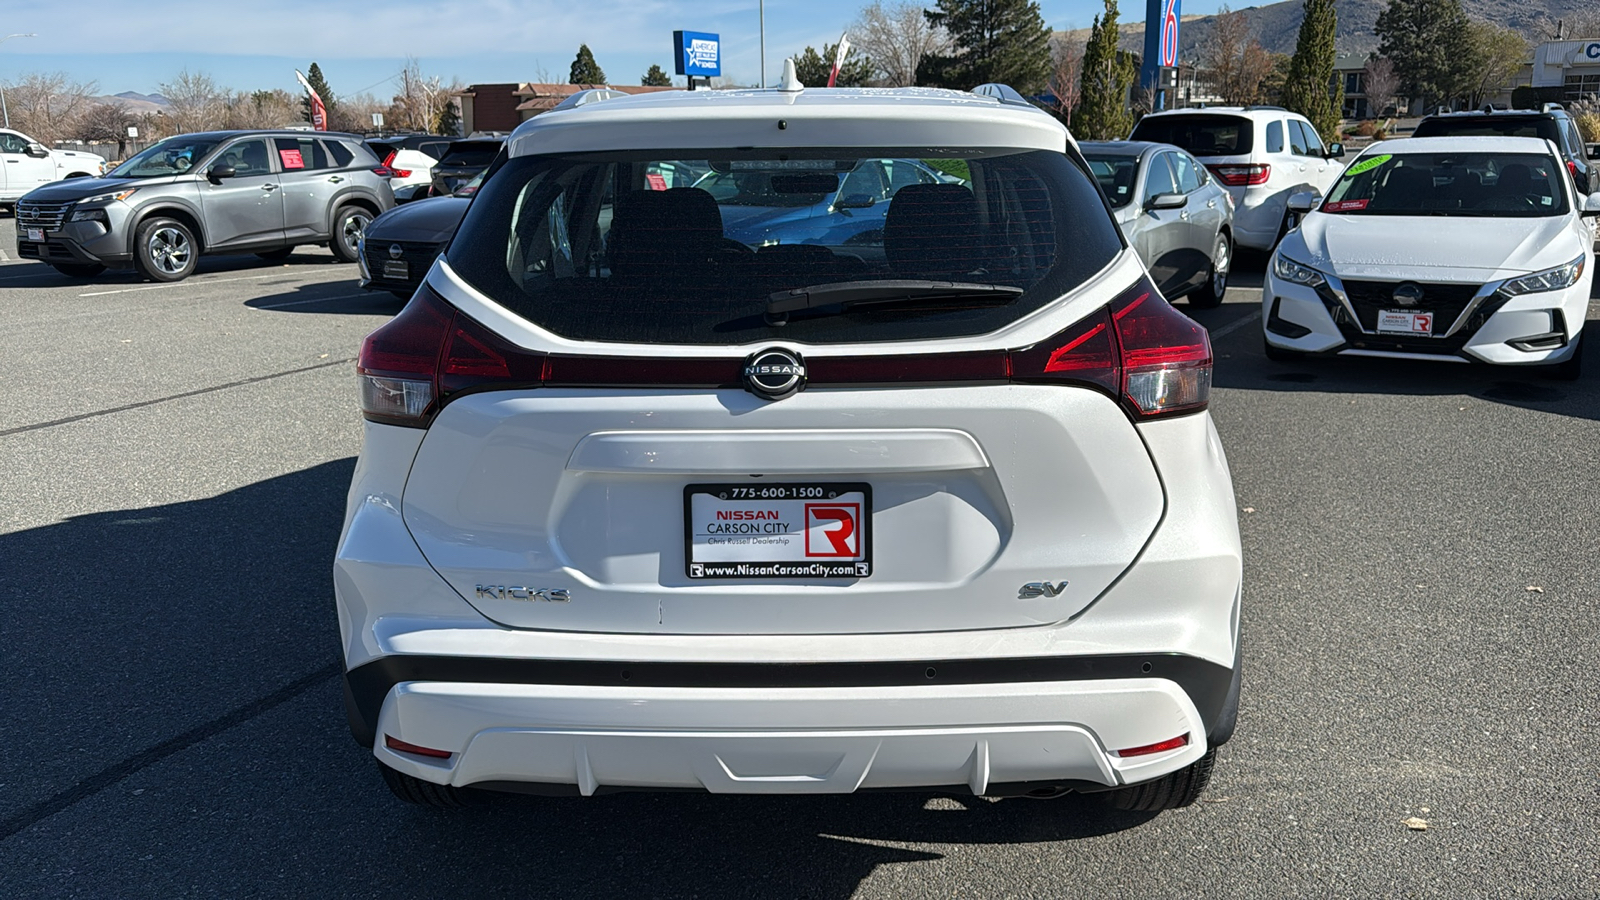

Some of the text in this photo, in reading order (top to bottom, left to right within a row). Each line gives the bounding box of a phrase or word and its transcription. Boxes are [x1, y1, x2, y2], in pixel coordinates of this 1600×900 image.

[1162, 0, 1178, 66] 6
[745, 365, 802, 374] NISSAN
[731, 487, 824, 498] 775-600-1500
[716, 510, 779, 520] NISSAN
[707, 522, 790, 534] CARSON CITY
[810, 508, 855, 556] R
[707, 537, 790, 547] Chris Russell Dealership
[705, 564, 854, 577] www.NissanCarsonCity.com
[475, 584, 571, 603] KICKS
[1017, 581, 1069, 600] SV
